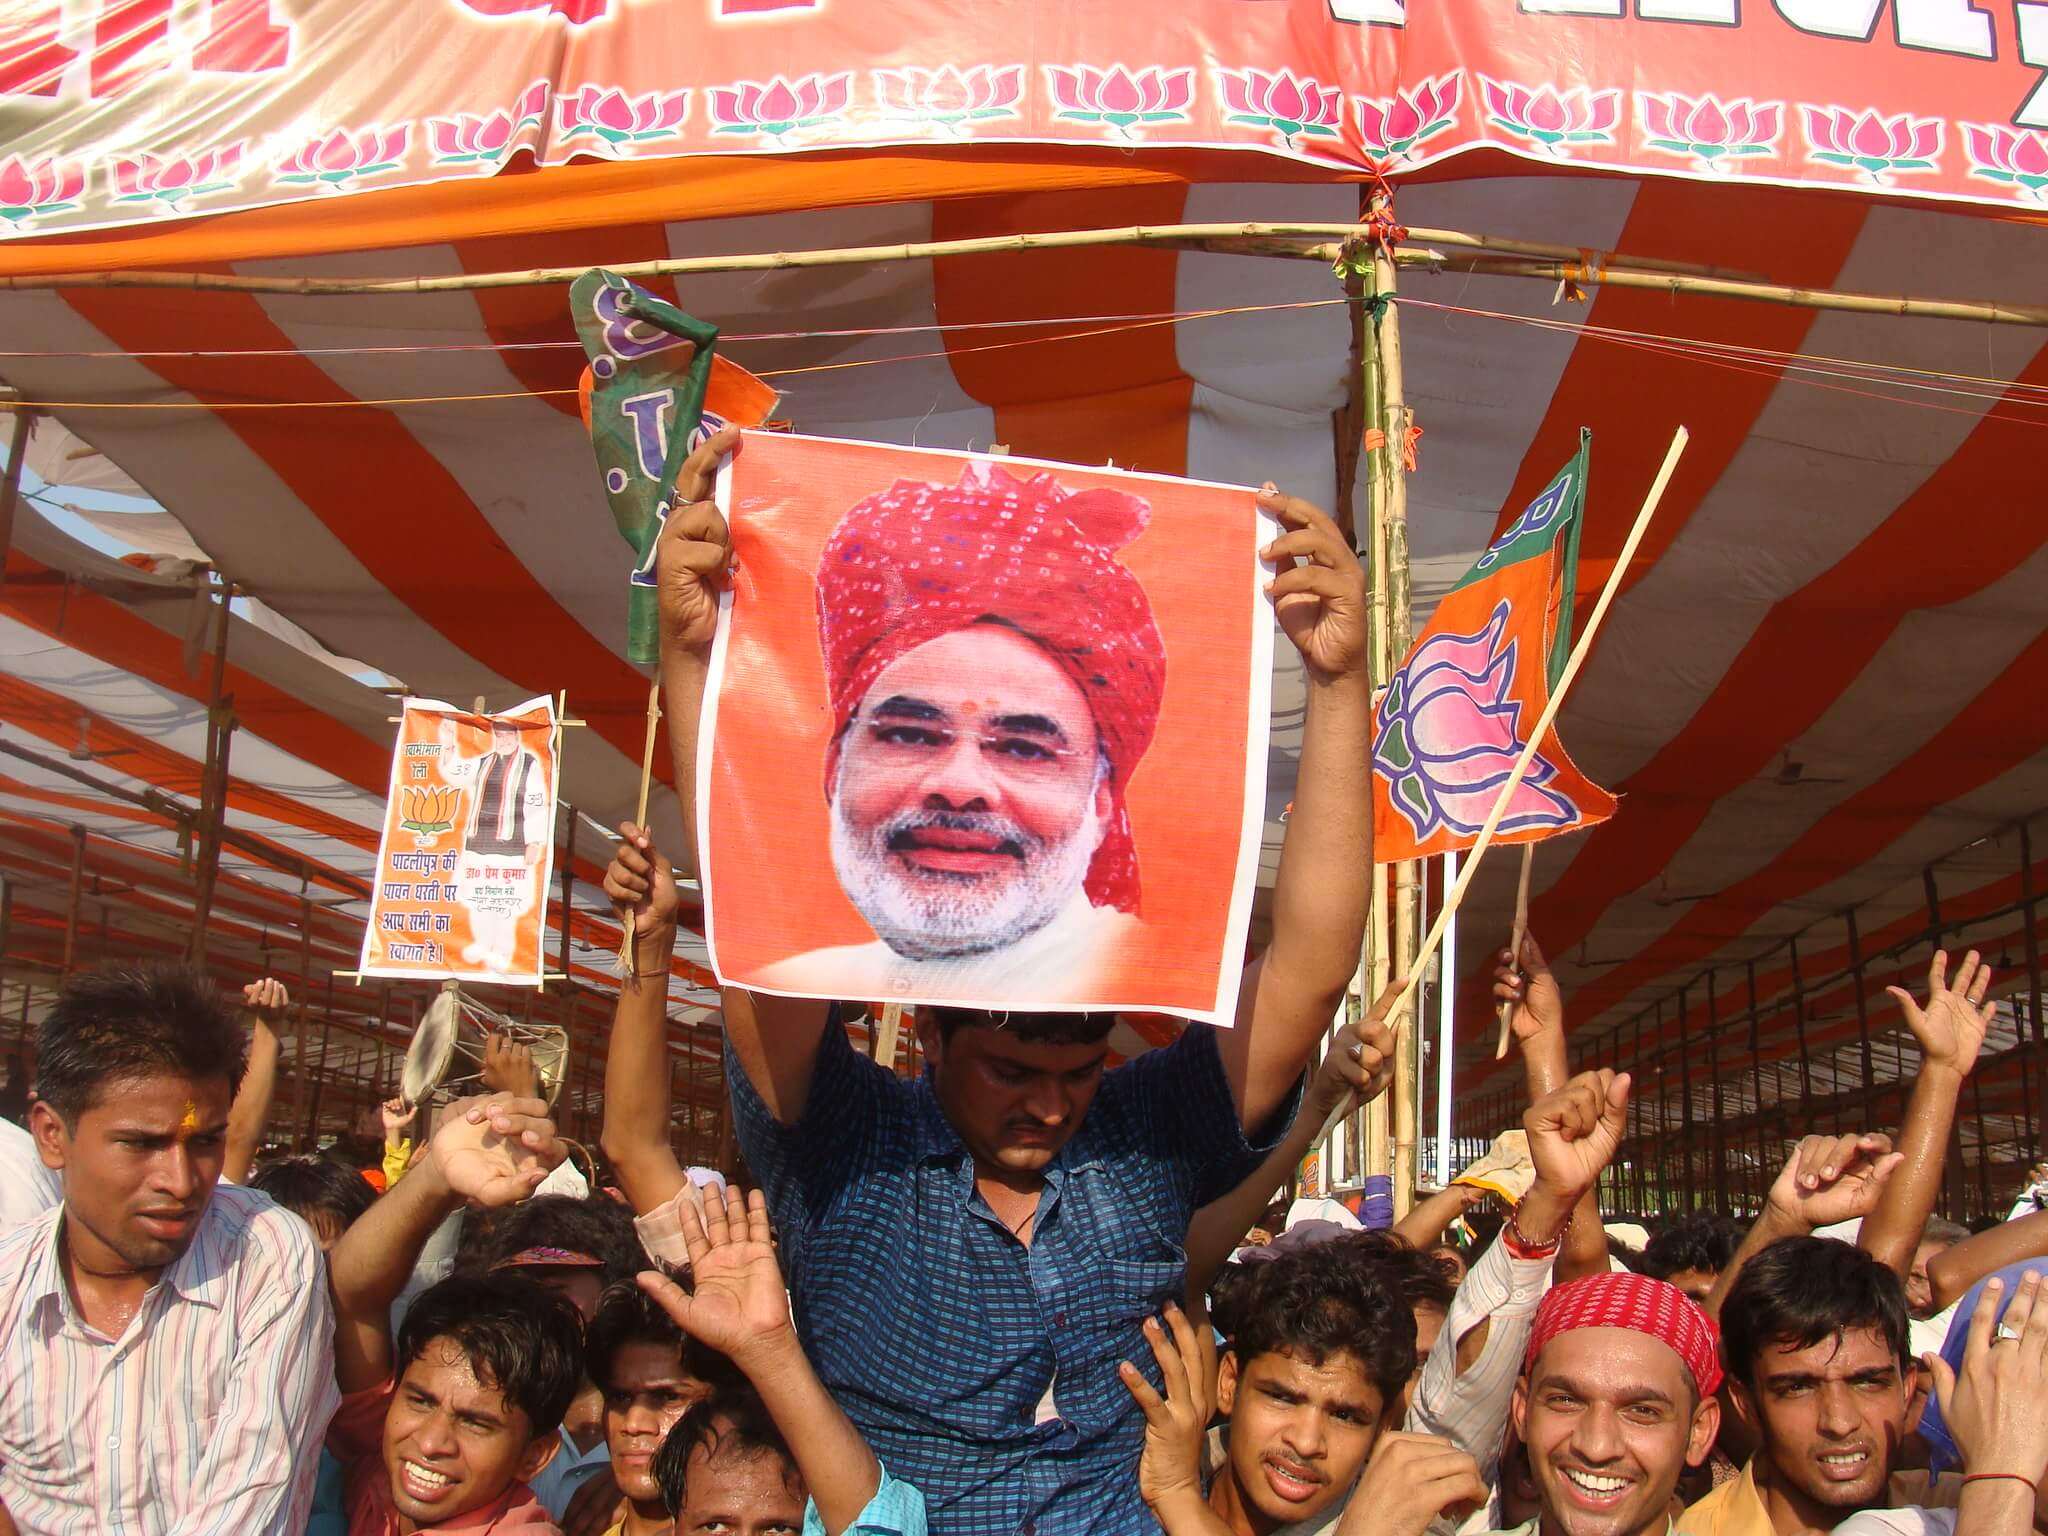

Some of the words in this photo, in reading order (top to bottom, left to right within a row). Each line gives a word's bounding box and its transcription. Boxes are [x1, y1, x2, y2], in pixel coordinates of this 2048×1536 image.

[393, 850, 438, 876] पाटलीपुत्र
[443, 850, 457, 870] की
[502, 868, 527, 884] कुमार
[384, 883, 410, 900] पावन
[444, 885, 458, 901] पर
[383, 913, 405, 930] आप
[435, 915, 450, 932] का
[390, 944, 424, 960] स्वागत
